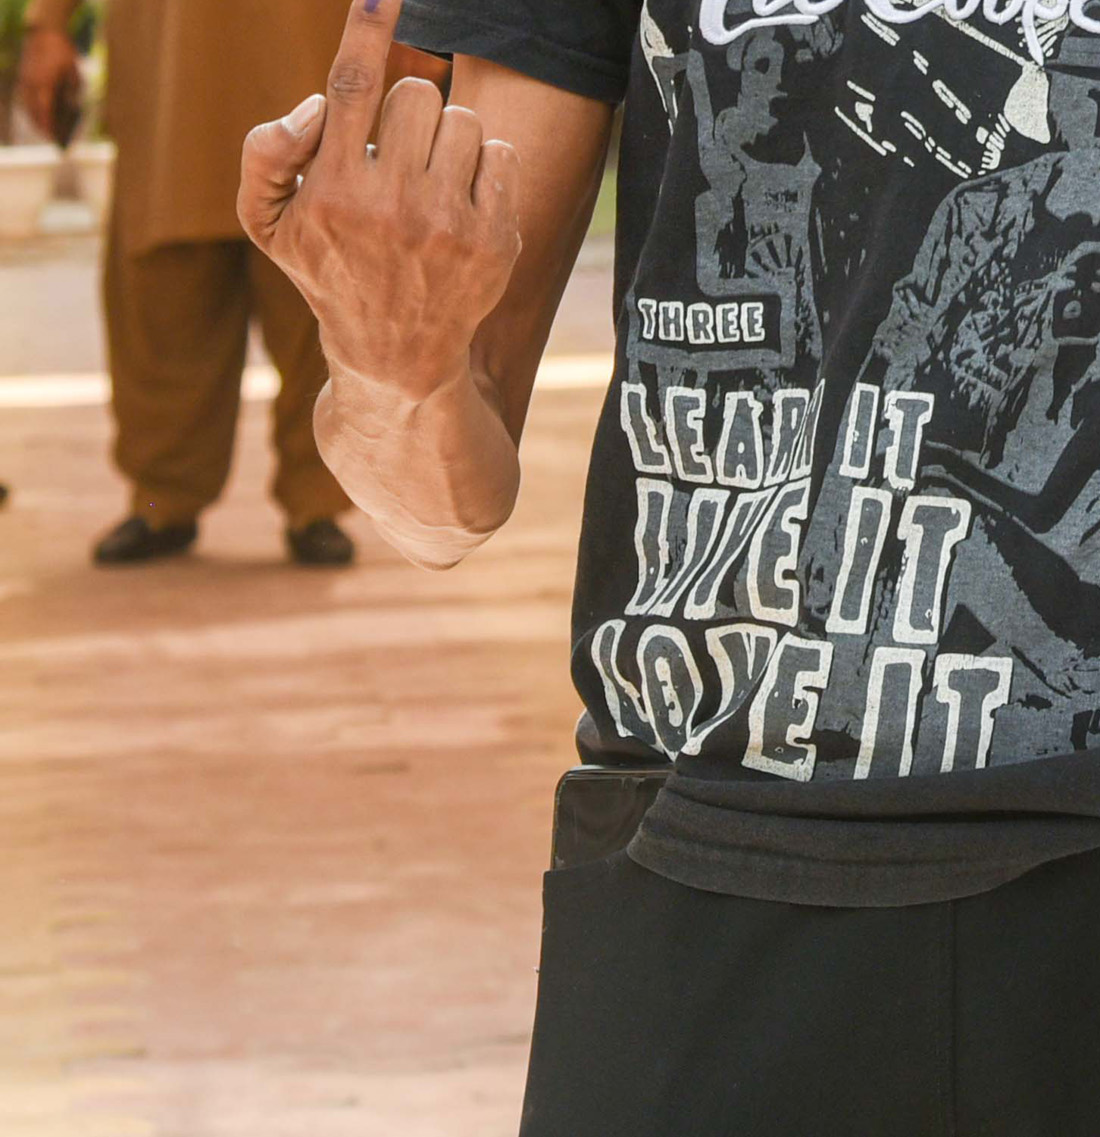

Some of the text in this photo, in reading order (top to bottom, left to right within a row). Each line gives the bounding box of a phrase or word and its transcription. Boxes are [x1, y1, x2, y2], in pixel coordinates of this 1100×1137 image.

[636, 298, 766, 344] THREE
[839, 382, 935, 491] IT
[624, 476, 972, 645] LIVE IT
[589, 617, 1014, 784] LOVE IT
